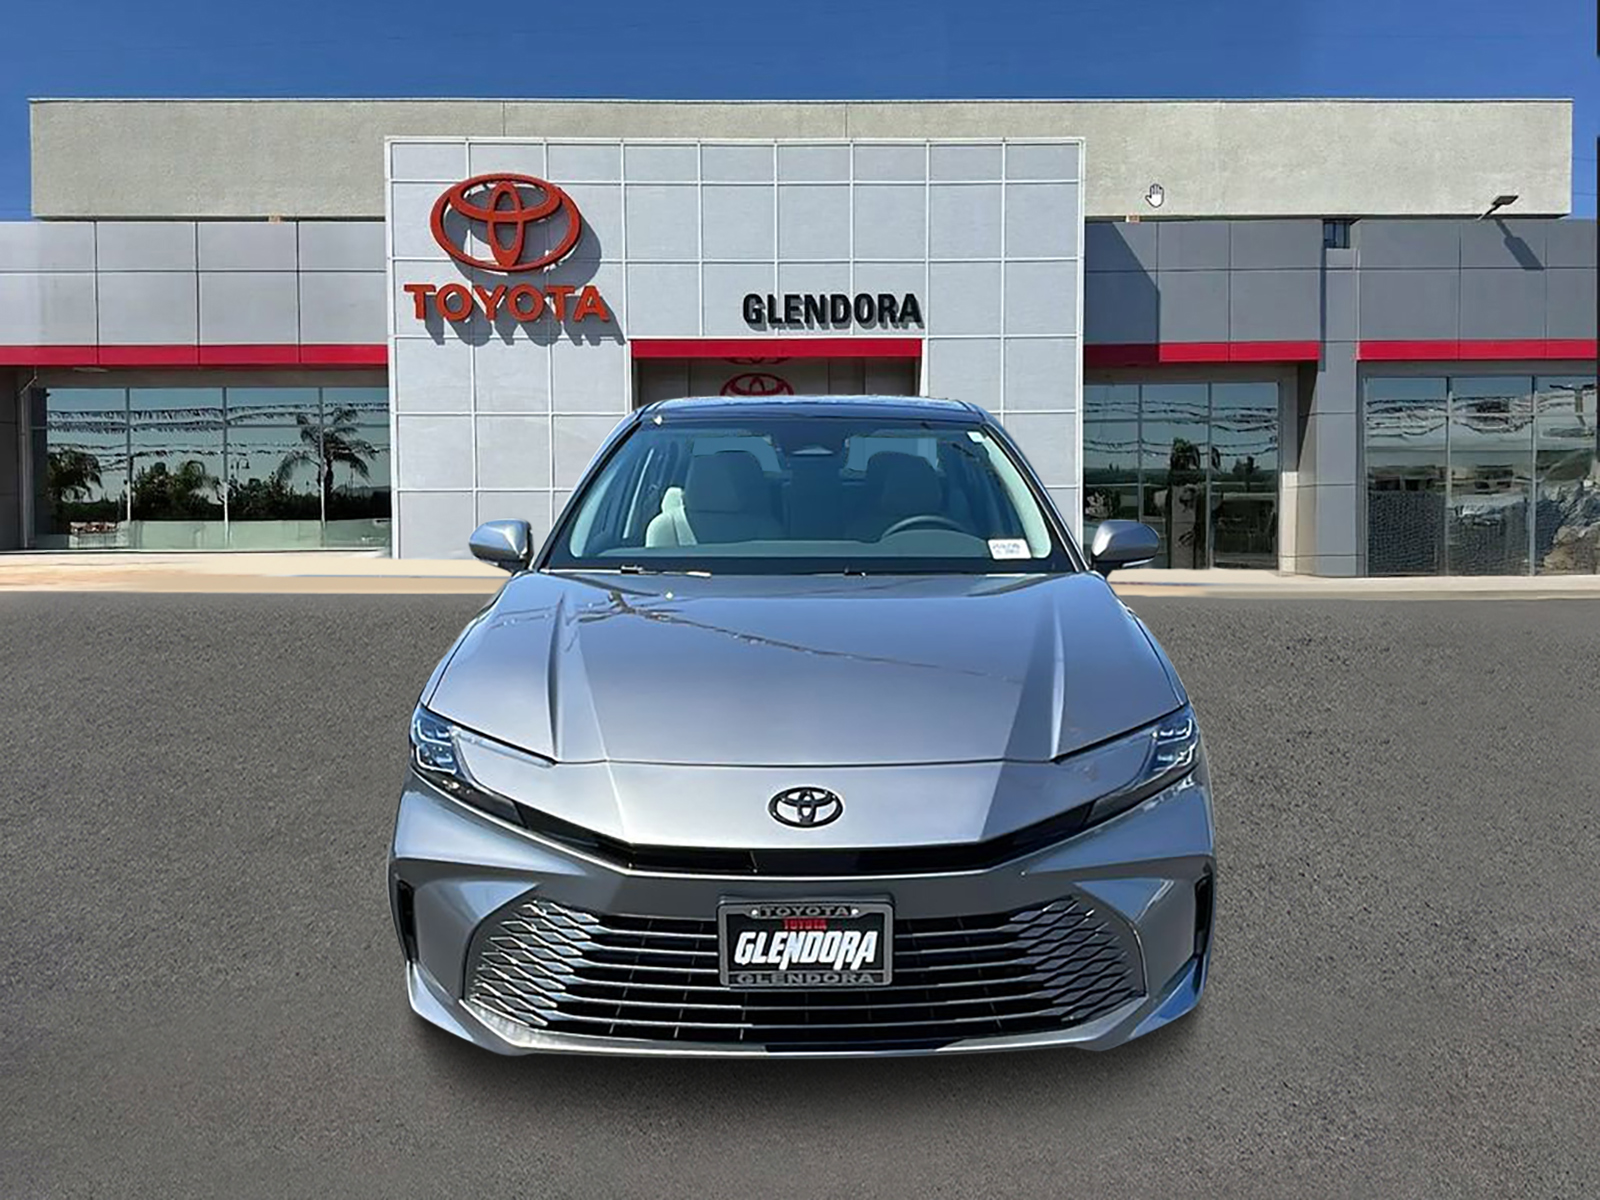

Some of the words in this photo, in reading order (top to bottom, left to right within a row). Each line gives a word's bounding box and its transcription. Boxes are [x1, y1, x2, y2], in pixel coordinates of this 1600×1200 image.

[404, 283, 611, 322] TOYOTA
[742, 292, 923, 326] GLENDORA
[762, 905, 849, 917] TOYOTA
[734, 931, 878, 970] GLENDORA
[736, 973, 875, 984] GLENDORA
